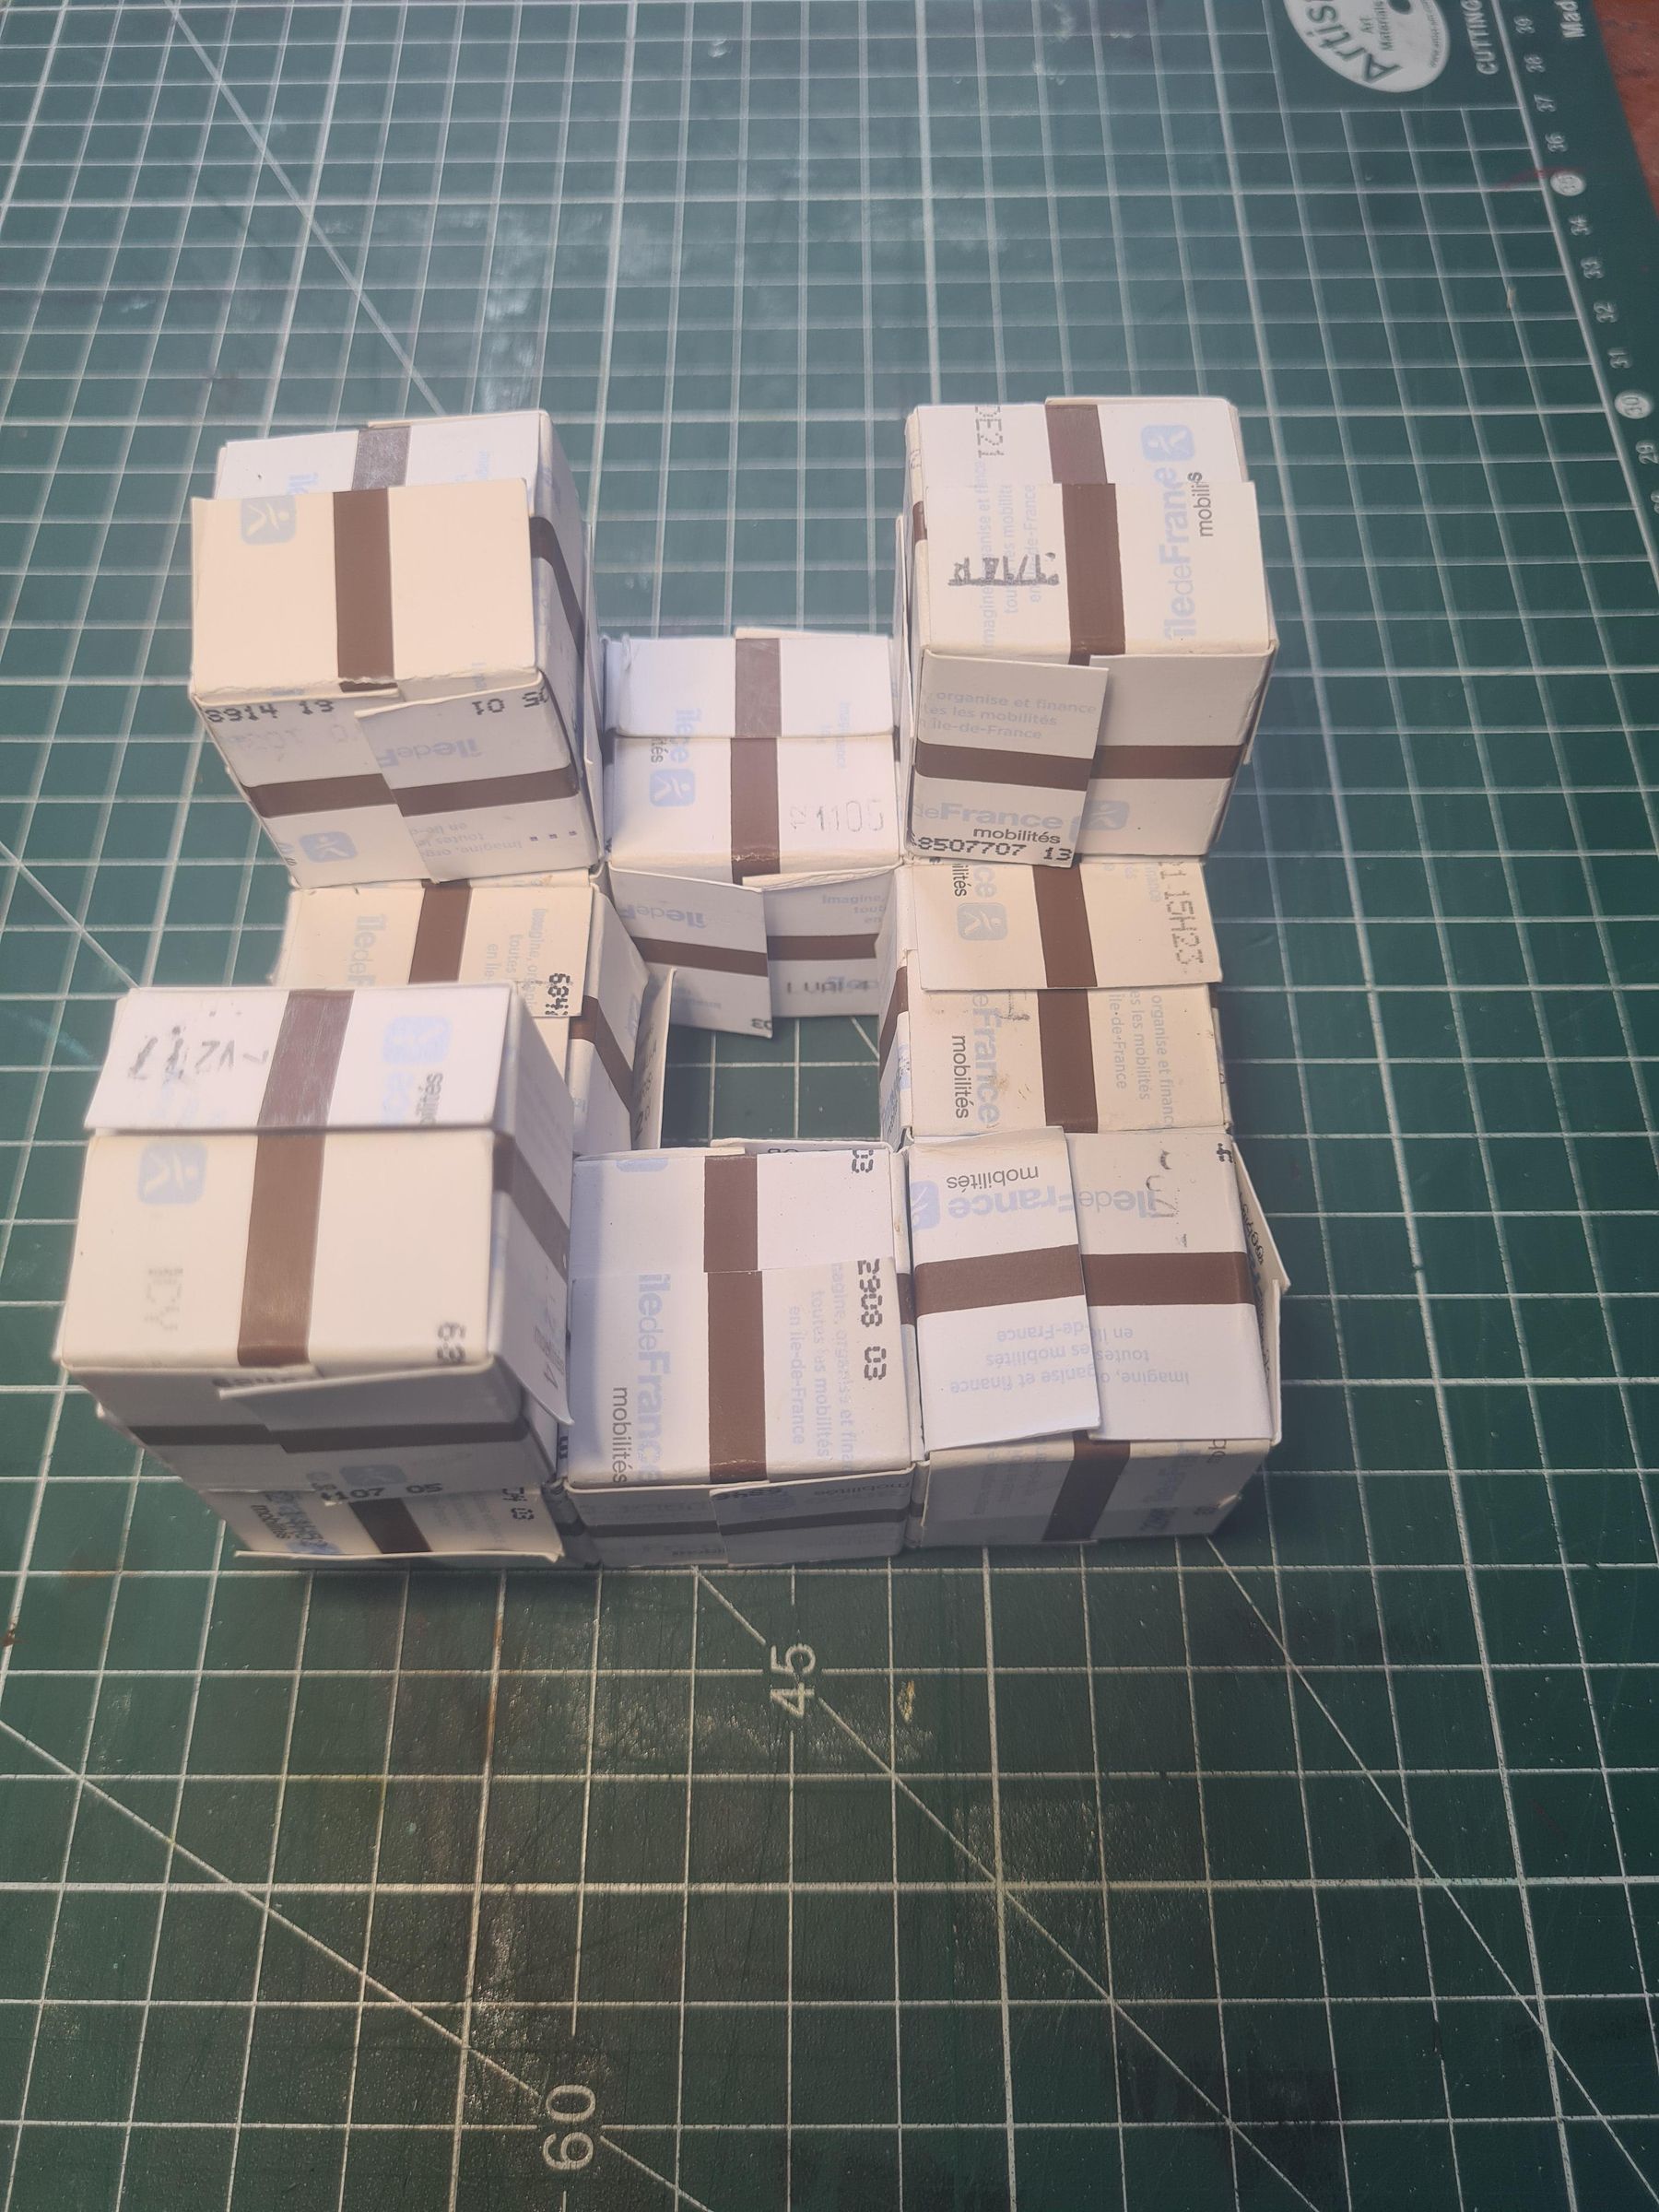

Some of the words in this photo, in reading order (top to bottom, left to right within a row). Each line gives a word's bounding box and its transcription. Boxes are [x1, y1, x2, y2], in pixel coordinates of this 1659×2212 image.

[1513, 15, 1535, 34] 39
[1524, 53, 1546, 73] 38
[1534, 94, 1557, 112] 37
[1545, 132, 1567, 153] 36
[1570, 214, 1593, 236] 34
[1580, 256, 1605, 279] 33
[1593, 300, 1618, 324] 32
[1607, 347, 1631, 369] 31
[1621, 390, 1644, 416] 30
[298, 698, 336, 715] 13
[935, 691, 1009, 708] organise
[1014, 697, 1033, 710] et
[1035, 699, 1098, 715] finance
[952, 705, 975, 719] les
[980, 707, 1058, 726] mobilités
[972, 826, 1062, 845] mobilités
[1041, 846, 1074, 862] 13
[1131, 1009, 1144, 1030] les
[1151, 994, 1168, 1056] organise
[951, 1034, 974, 1120] mobilités
[1134, 1032, 1150, 1100] mobilités
[1157, 1059, 1171, 1076] et
[946, 1165, 1041, 1194] mobilités
[863, 1346, 888, 1381] 03
[985, 1347, 1067, 1370] mobilités
[949, 1374, 1014, 1394] finance
[1017, 1371, 1036, 1384] et
[612, 1386, 633, 1483] mobilités
[769, 1641, 818, 1719] 45
[541, 2082, 597, 2172] 60
